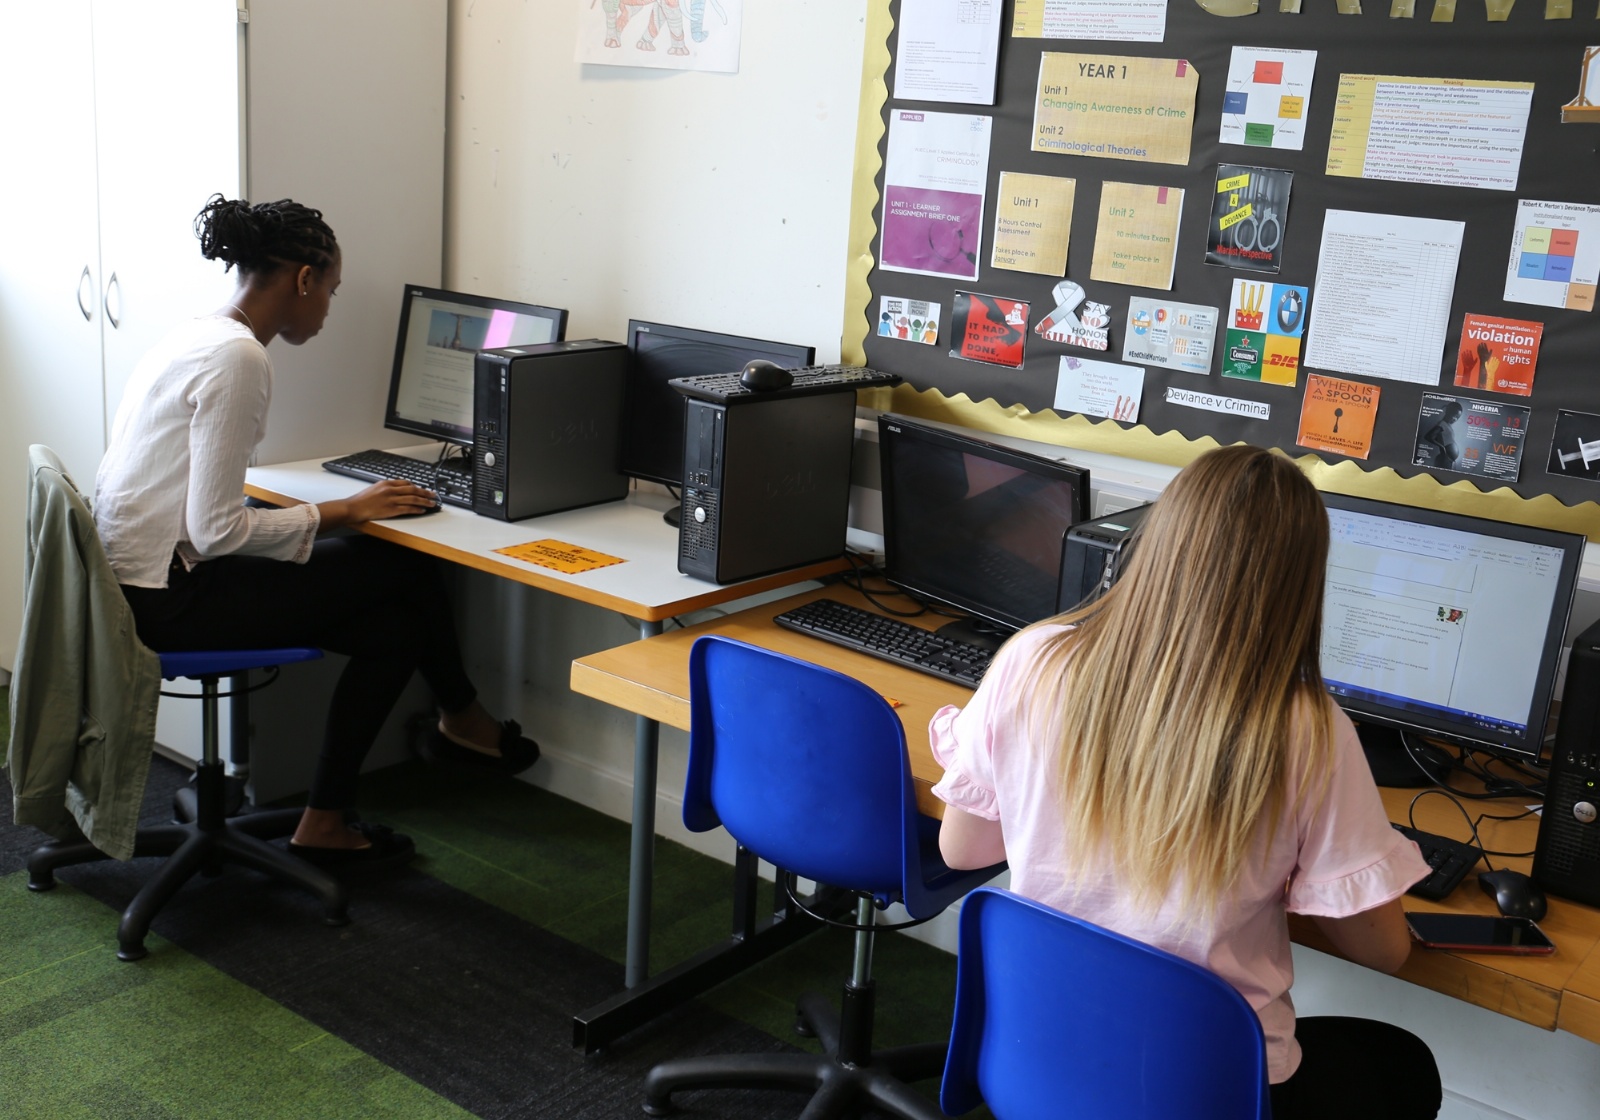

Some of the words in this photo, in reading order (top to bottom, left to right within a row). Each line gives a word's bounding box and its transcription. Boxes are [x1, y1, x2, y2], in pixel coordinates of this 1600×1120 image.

[1079, 63, 1115, 79] YEAR
[1122, 66, 1128, 80] 1
[1044, 85, 1061, 95] Unit
[1064, 87, 1068, 95] 1
[1043, 99, 1088, 112] Changing
[1091, 103, 1141, 115] Awareness
[1145, 107, 1155, 116] of
[1157, 107, 1186, 118] Crime
[1040, 125, 1056, 134] Unit
[1058, 126, 1064, 135] 2
[1038, 138, 1104, 153] Criminological
[1107, 144, 1146, 156] Theories
[937, 157, 979, 166] CRIMINOLOGY
[1226, 180, 1240, 189] CRIME
[913, 203, 940, 211] LEARNER
[1014, 197, 1031, 207] Unit
[1035, 199, 1038, 208] 1
[891, 209, 927, 218] ASSIGNMENT
[1109, 207, 1126, 217] Unit
[1129, 209, 1135, 218] 2
[1225, 210, 1247, 226] DEVIANCE
[998, 226, 1030, 235] Assessment
[1125, 232, 1150, 240] minutes
[1152, 235, 1170, 243] Exam
[1216, 245, 1238, 256] Marxist
[1239, 248, 1272, 260] Perspective
[994, 255, 1016, 264] January
[1282, 291, 1301, 303] BUY
[1084, 301, 1110, 314] SAY
[1081, 315, 1101, 327] NO
[983, 324, 1005, 334] HAD
[1072, 327, 1107, 339] HONOR
[1042, 330, 1107, 351] KILLINGS
[1468, 328, 1534, 346] violation
[967, 343, 999, 357] DONE,
[1233, 350, 1254, 360] Consume
[1509, 346, 1532, 354] human
[1129, 350, 1167, 363] #EndChildMarriage
[1502, 354, 1530, 365] rights
[1316, 378, 1358, 393] WHEN
[1362, 387, 1373, 396] IS
[1167, 388, 1213, 406] Deviance
[1327, 390, 1371, 404] SPOON
[1345, 401, 1370, 409] SPOON?
[1472, 404, 1498, 413] NIGERIA
[1507, 416, 1520, 428] 13
[1306, 435, 1363, 450] #EndForcedMarriage
[1464, 447, 1478, 459] 35
[1493, 443, 1517, 455] VVF
